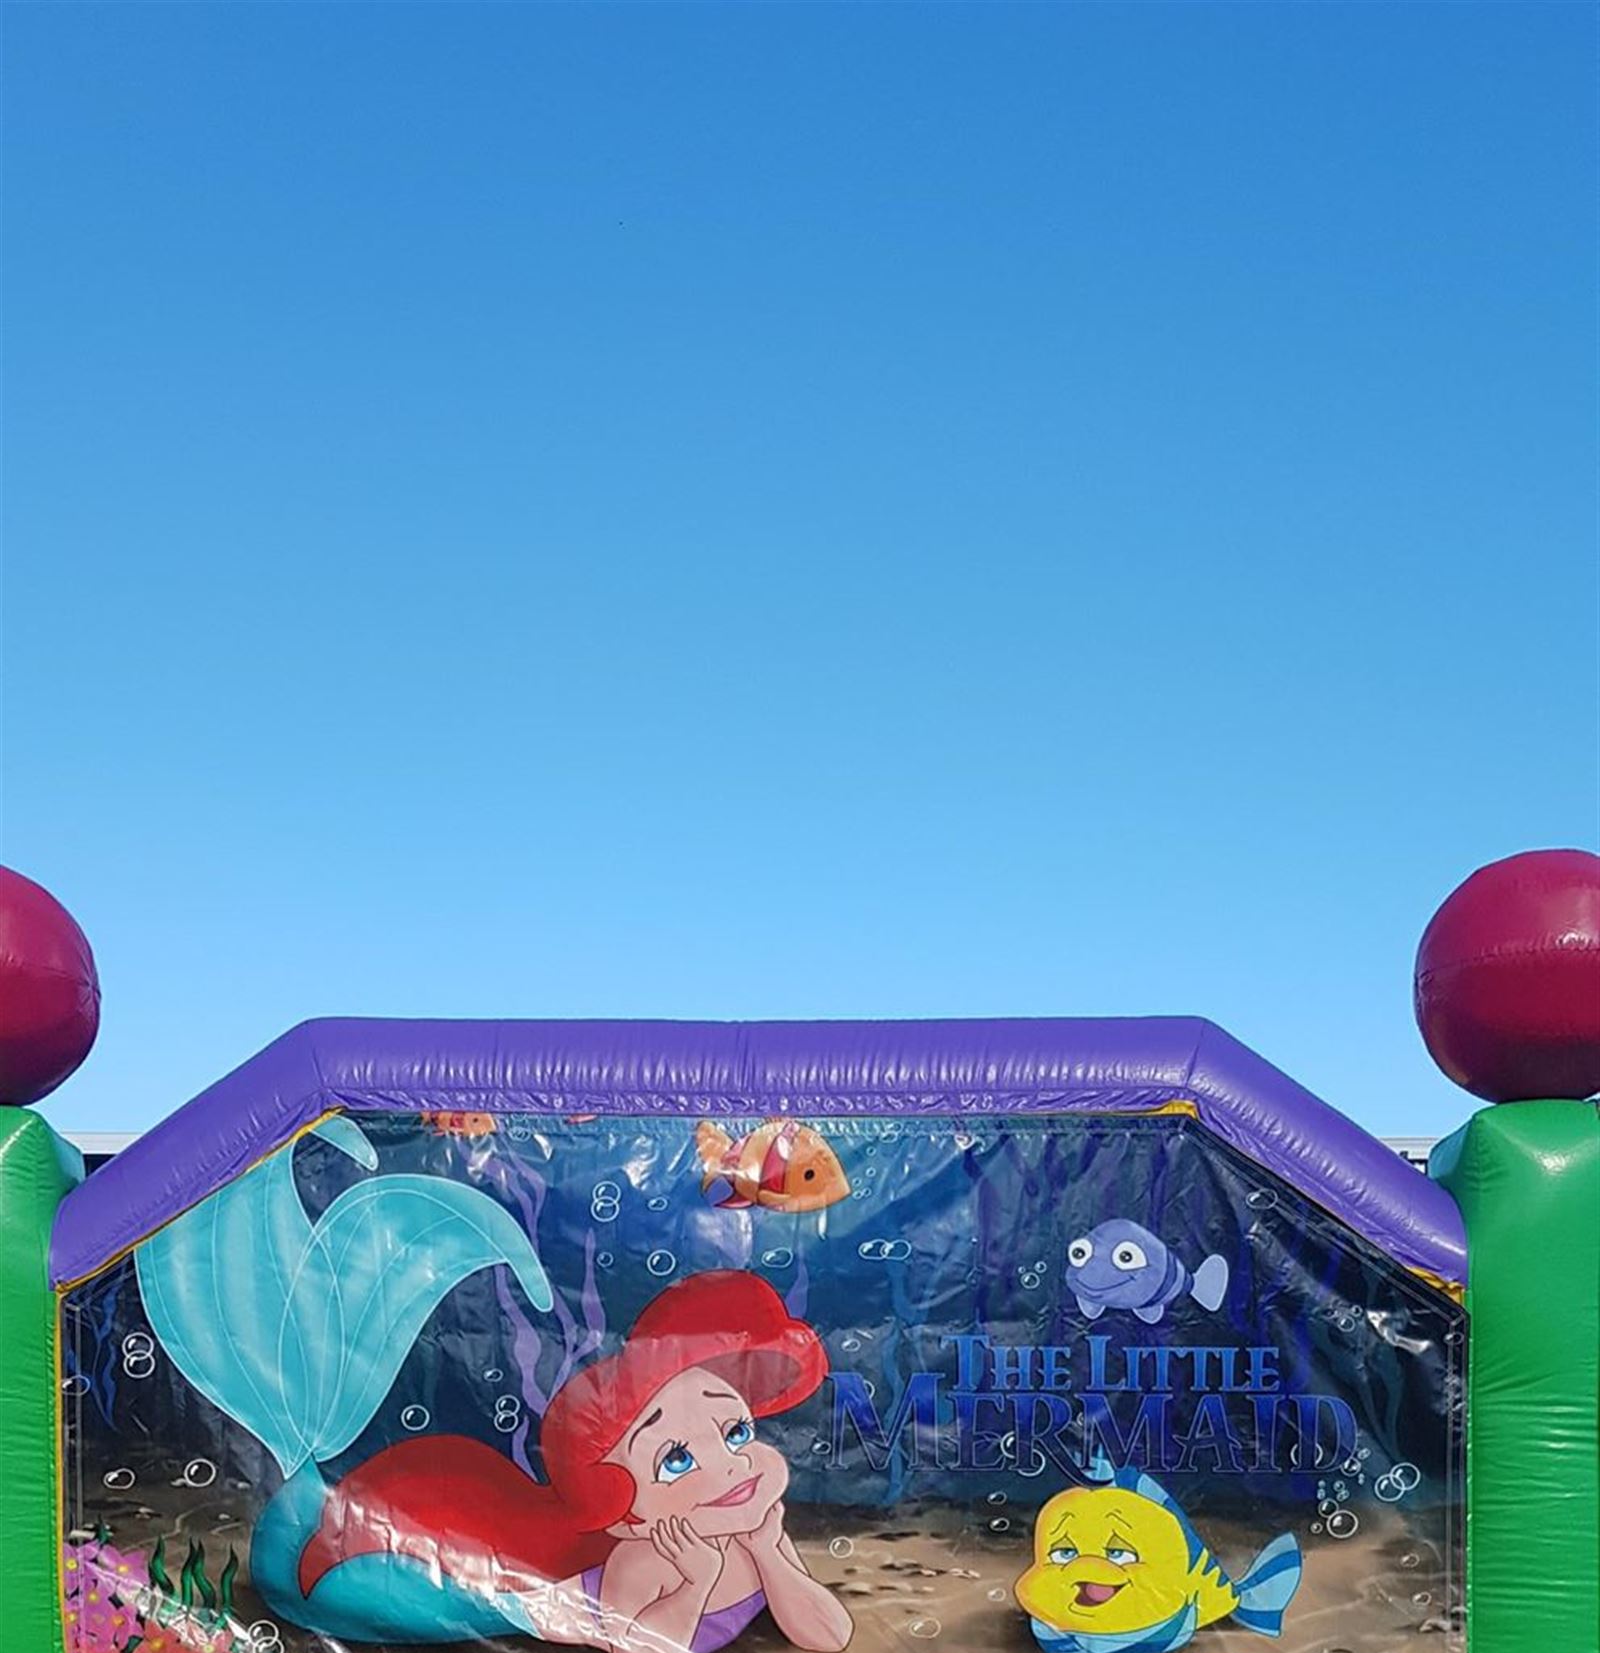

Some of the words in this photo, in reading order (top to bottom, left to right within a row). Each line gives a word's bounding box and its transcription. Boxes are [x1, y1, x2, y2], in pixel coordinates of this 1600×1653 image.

[940, 1334, 1073, 1392] THE
[1085, 1335, 1281, 1394] LITTLE
[826, 1371, 1358, 1487] MERMAID
